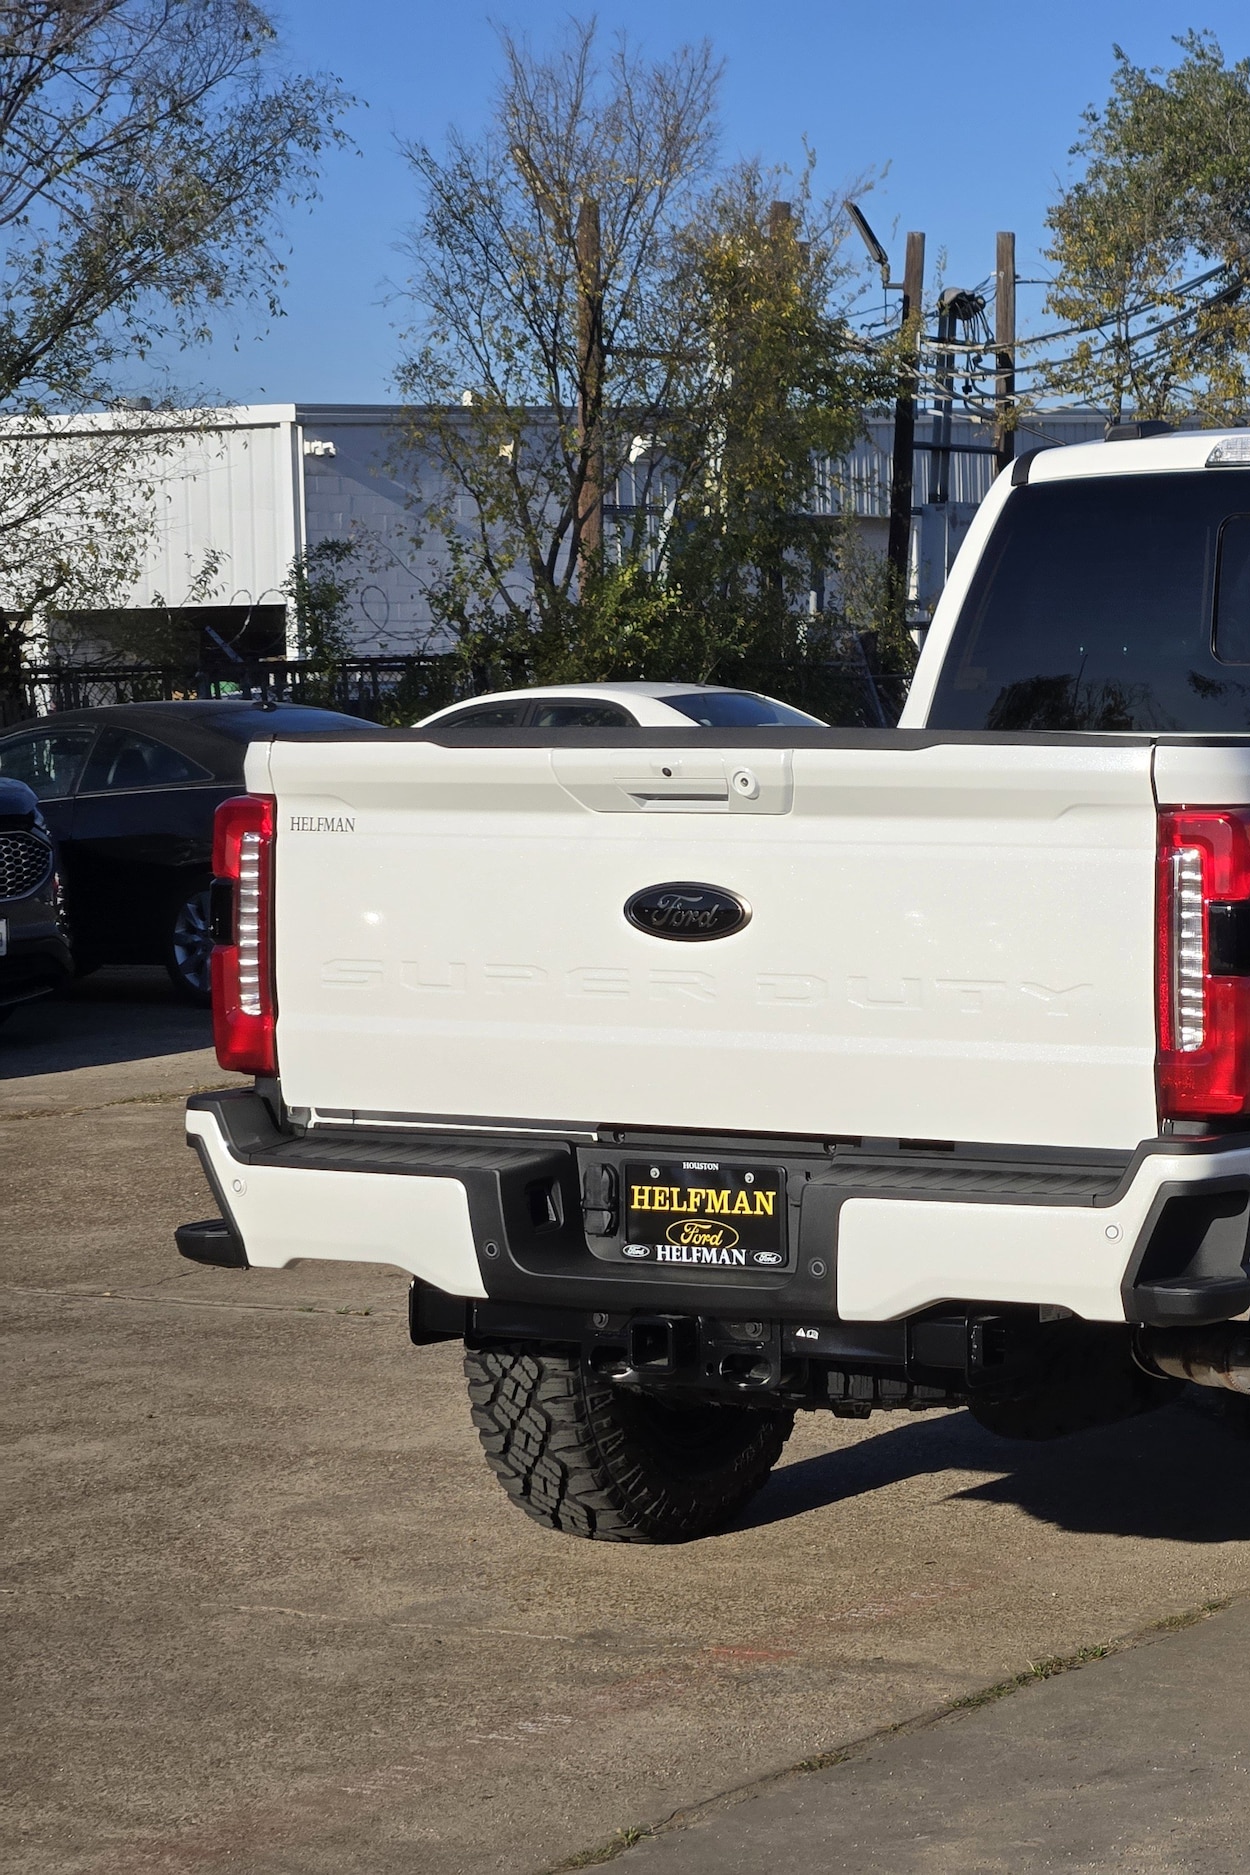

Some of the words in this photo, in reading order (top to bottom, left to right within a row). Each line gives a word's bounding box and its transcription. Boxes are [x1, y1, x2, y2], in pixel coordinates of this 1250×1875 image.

[290, 816, 356, 833] HELFMAN
[651, 893, 720, 929] Ford
[320, 958, 718, 1002] SUPER
[756, 972, 1094, 1017] DUTY
[682, 1161, 720, 1171] HOUSTON
[630, 1185, 777, 1216] HELFMAN
[680, 1222, 724, 1247] Ford
[655, 1244, 747, 1266] HELFMAN
